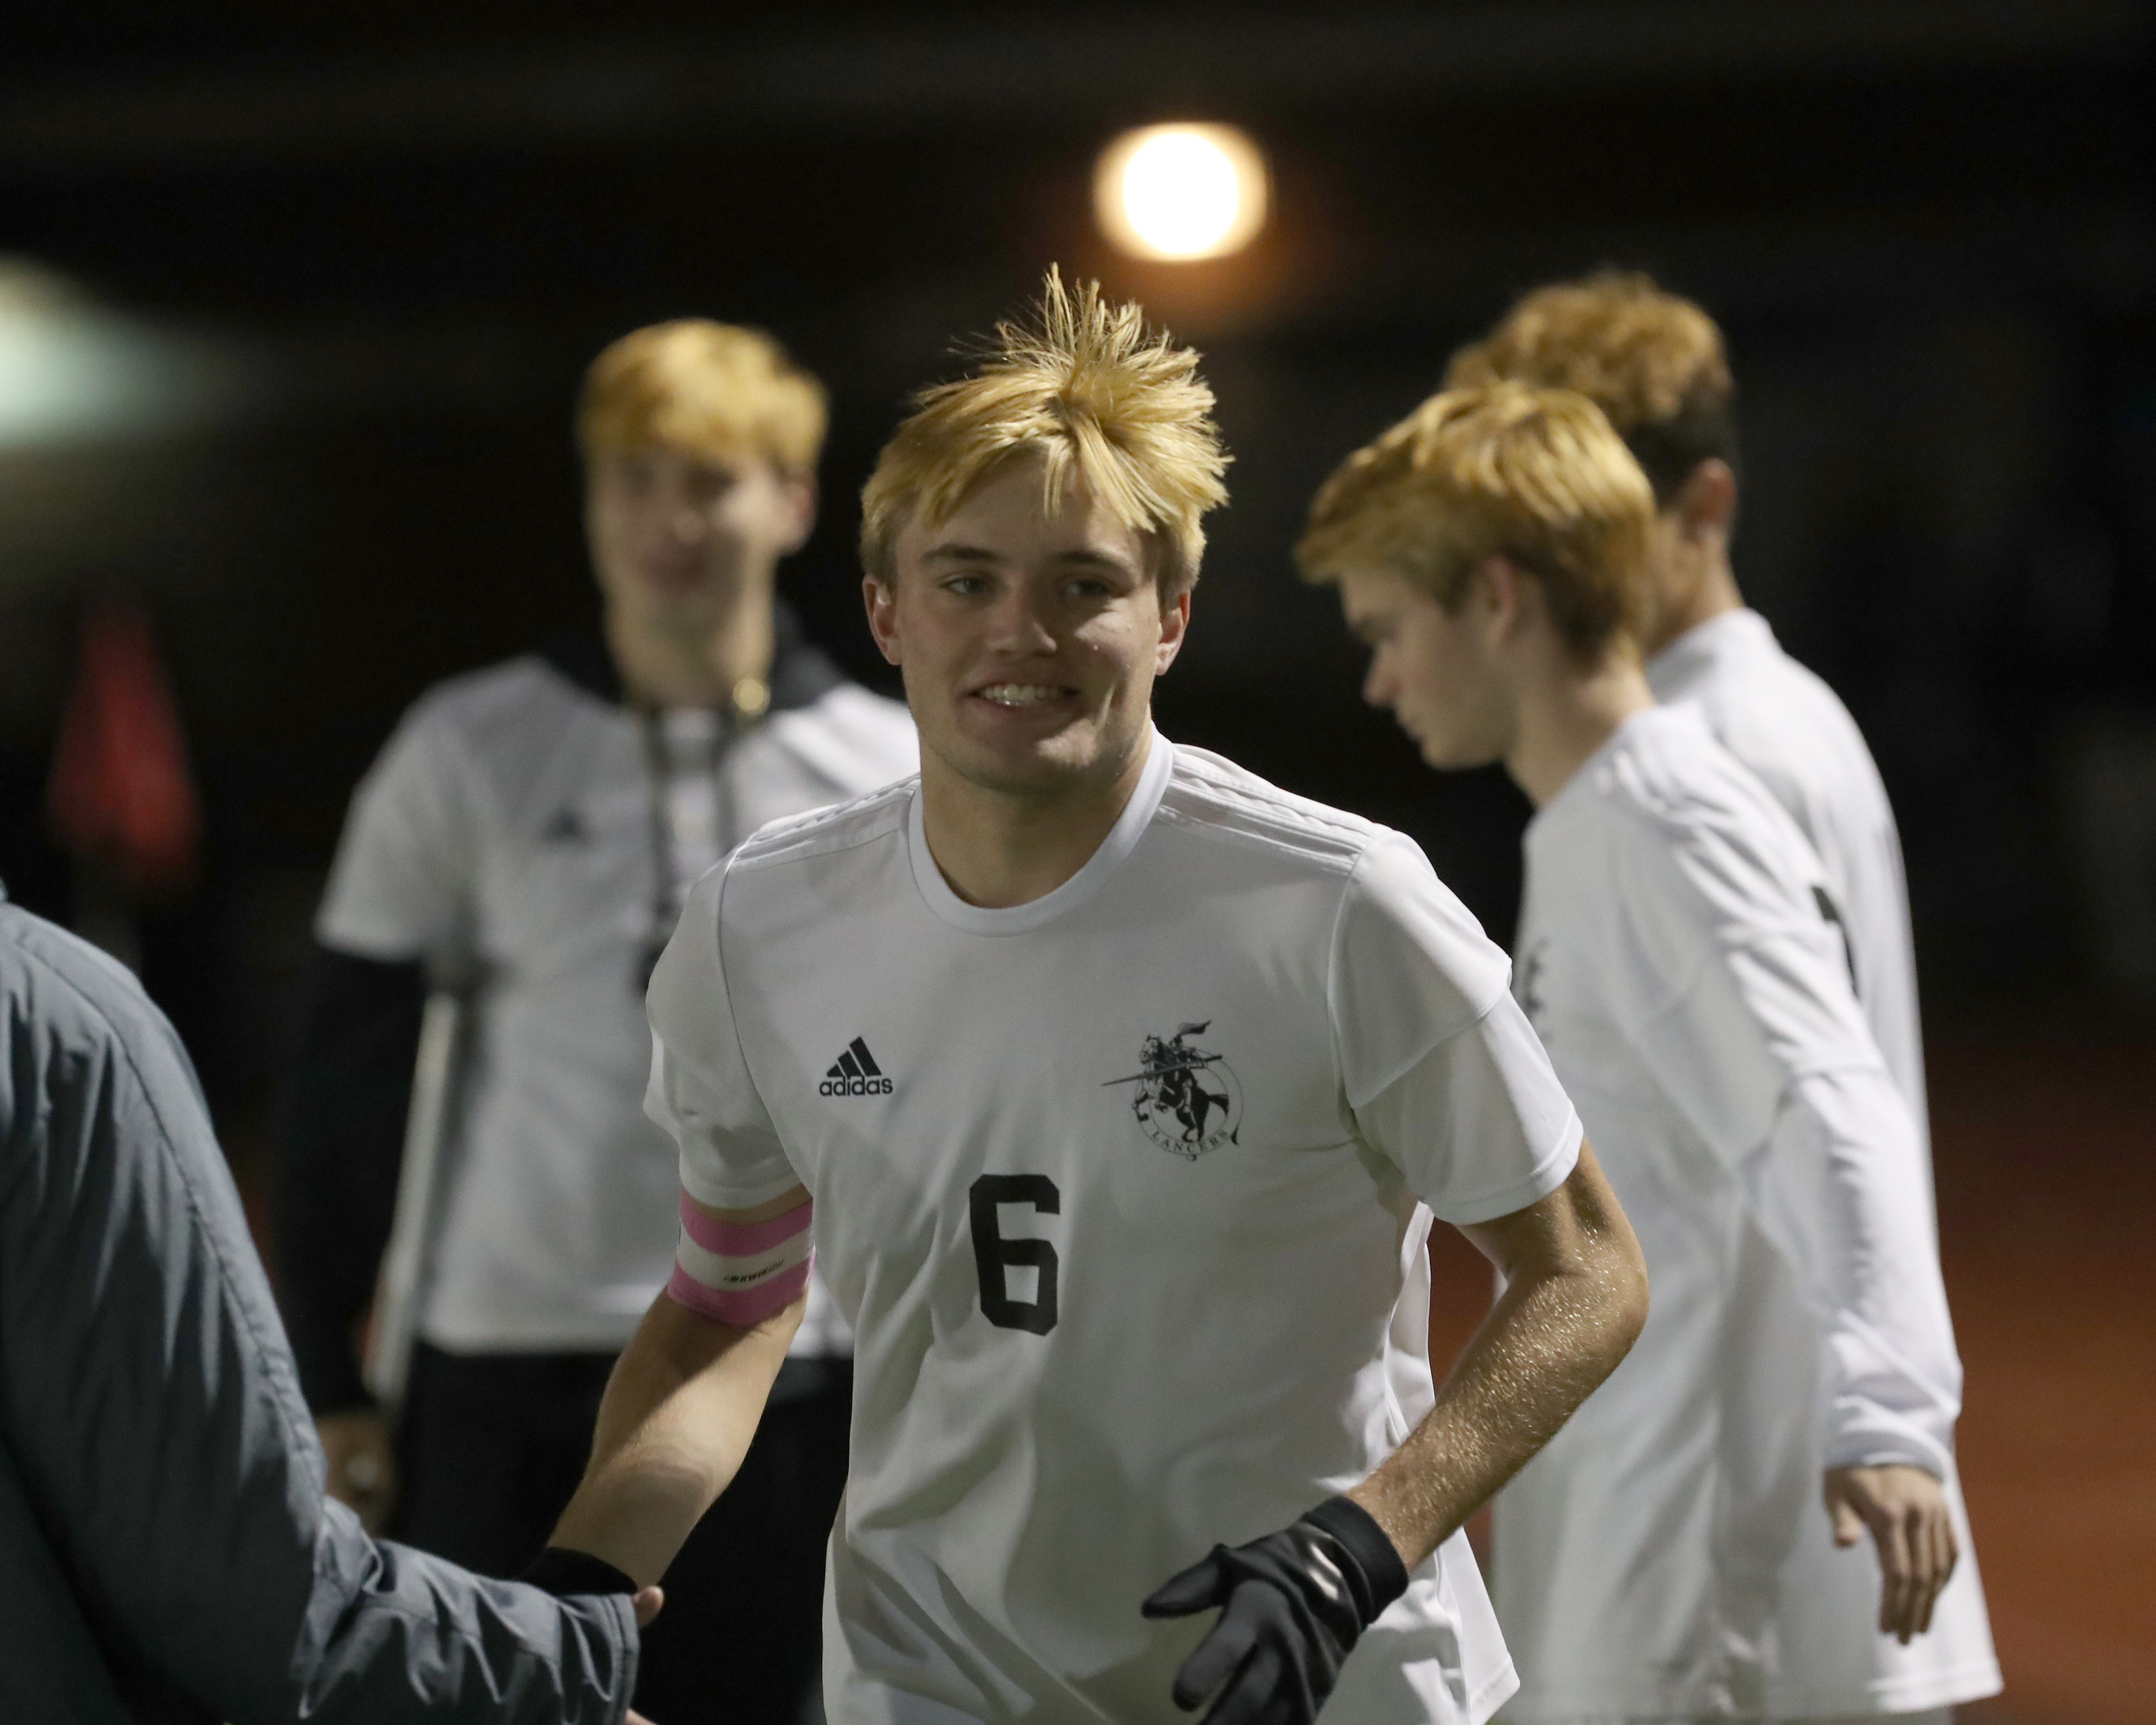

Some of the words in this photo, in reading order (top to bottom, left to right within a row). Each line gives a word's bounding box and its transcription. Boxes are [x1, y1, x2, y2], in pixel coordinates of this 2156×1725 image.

[819, 1076, 893, 1096] adidas
[1152, 1130, 1228, 1152] LANCERS
[969, 1174, 1060, 1337] 6
